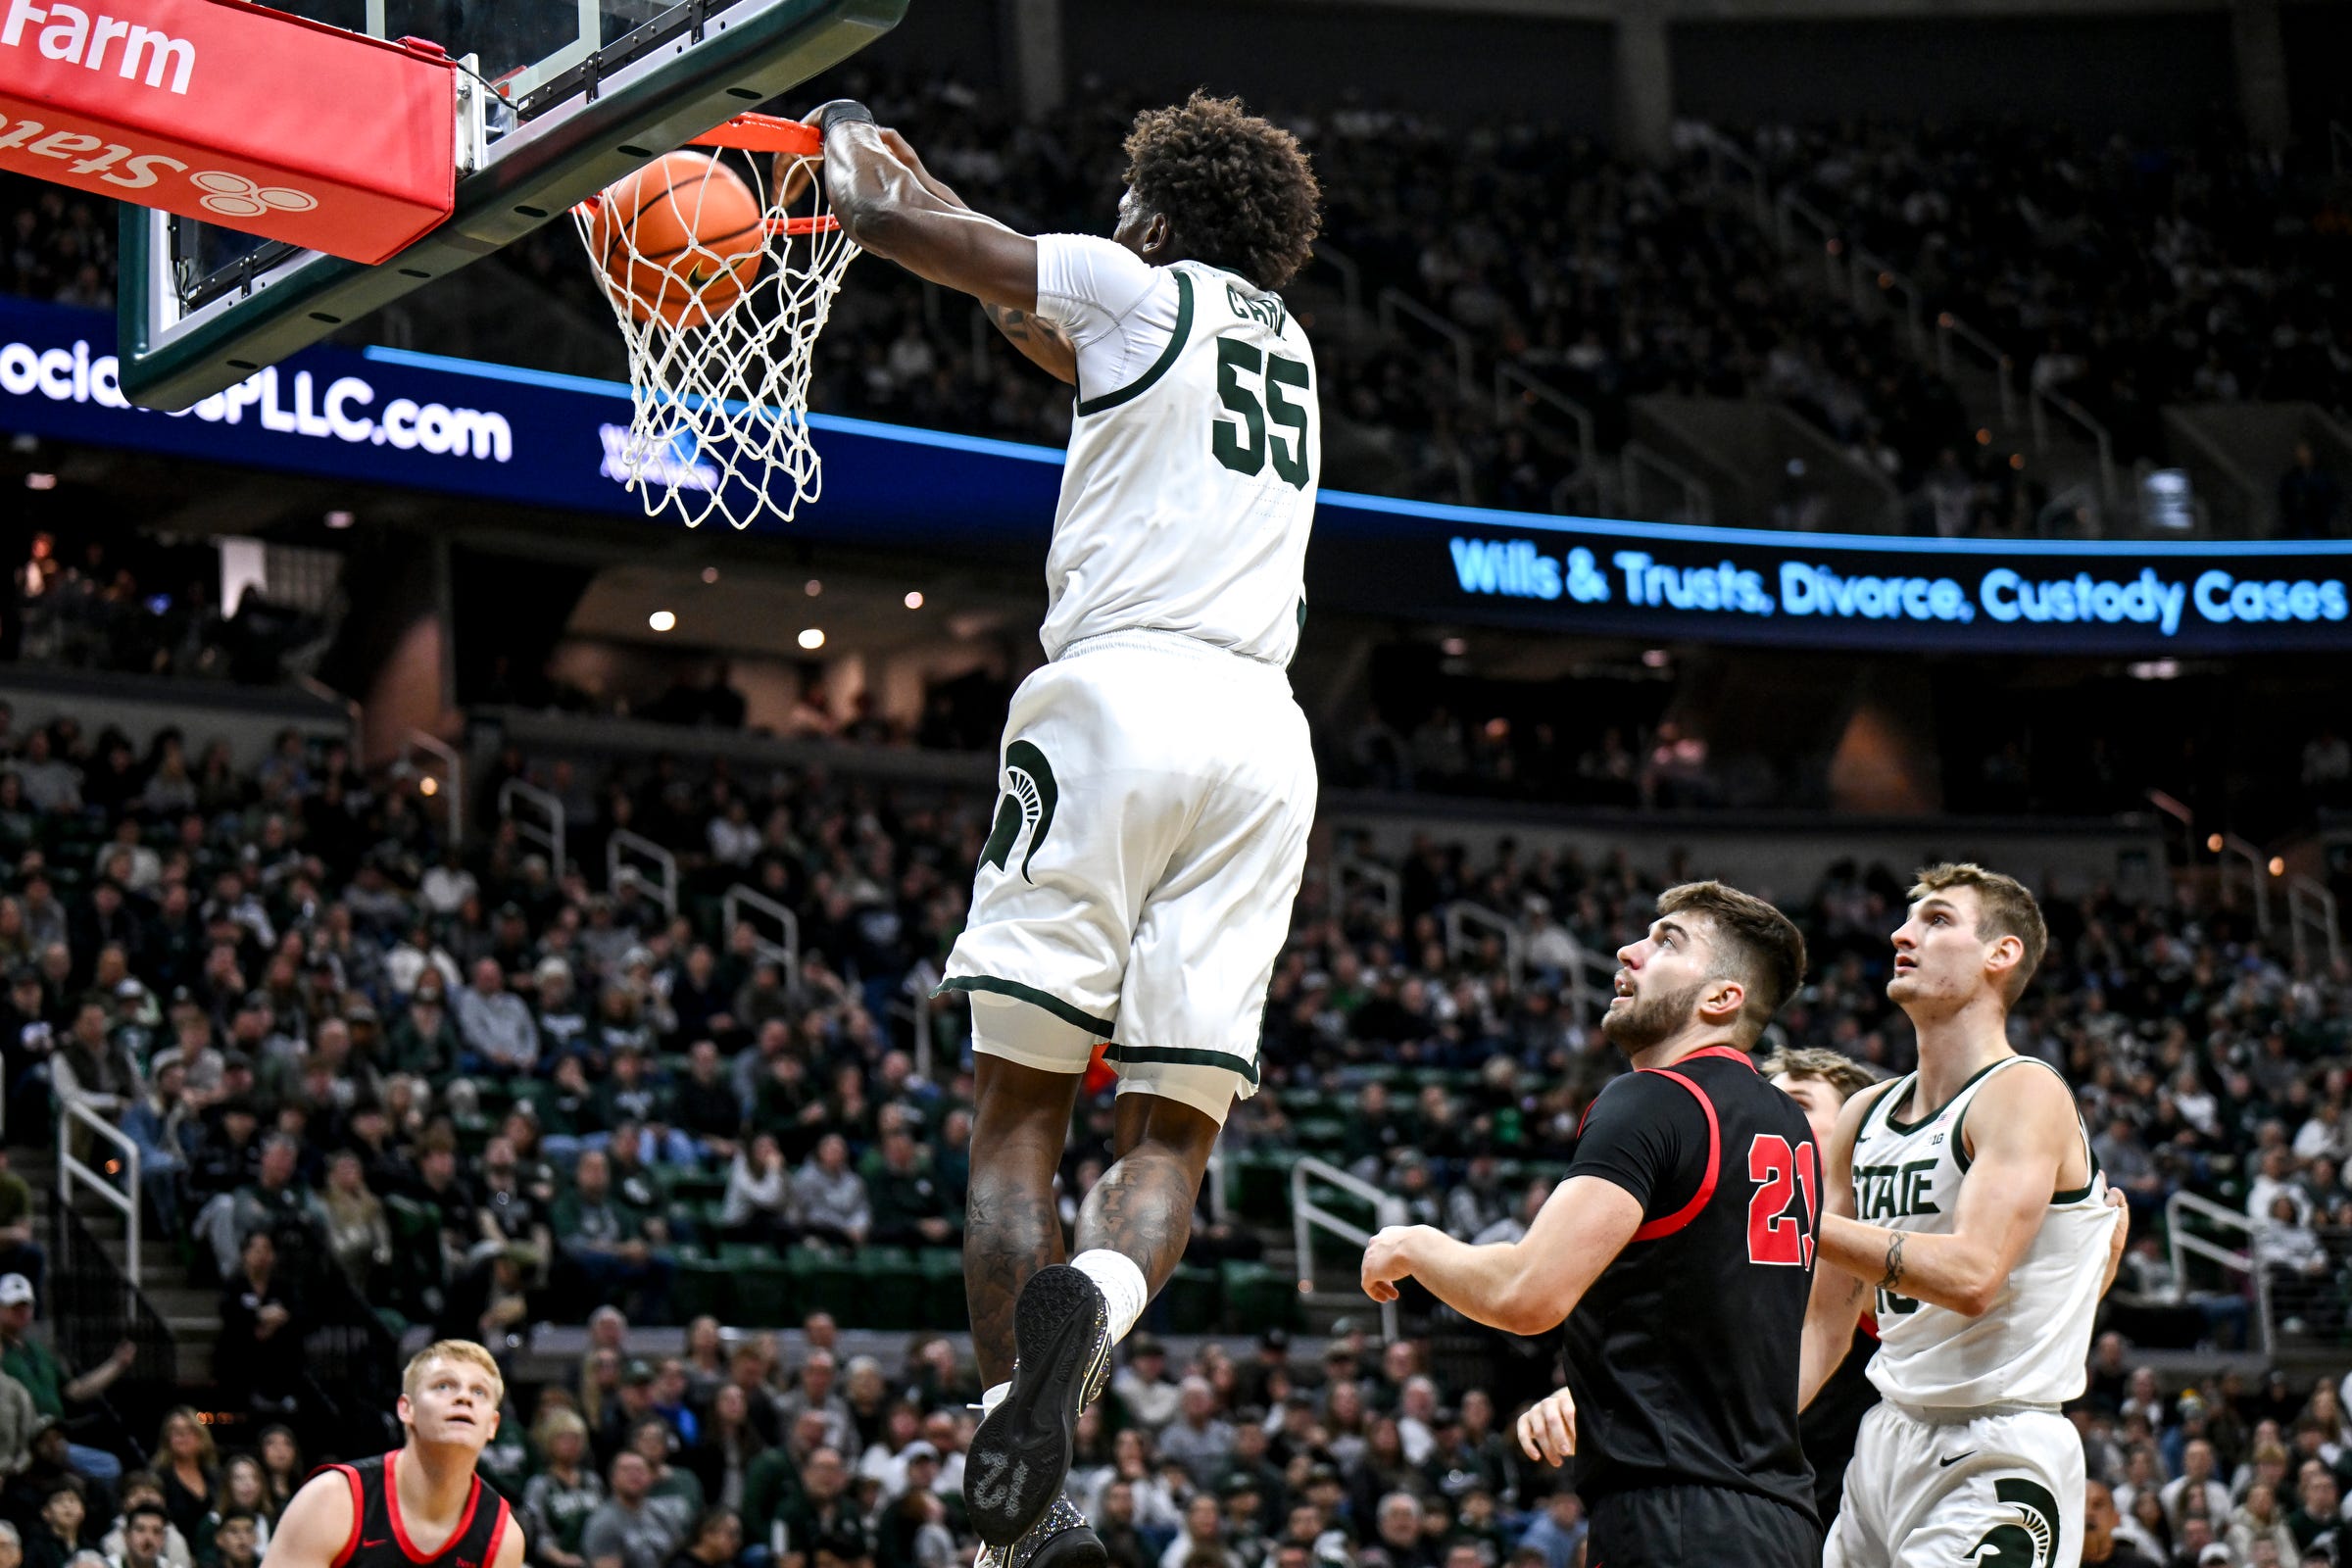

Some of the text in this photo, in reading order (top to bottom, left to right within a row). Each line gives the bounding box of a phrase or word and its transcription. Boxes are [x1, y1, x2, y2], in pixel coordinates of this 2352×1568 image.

[1, 0, 196, 95] Farm
[0, 113, 189, 189] Stat
[1212, 336, 1310, 492] 55
[1449, 537, 1561, 600] Wills
[1568, 547, 1610, 603] &
[1980, 566, 2185, 637] Custody
[2193, 568, 2349, 622] Cases
